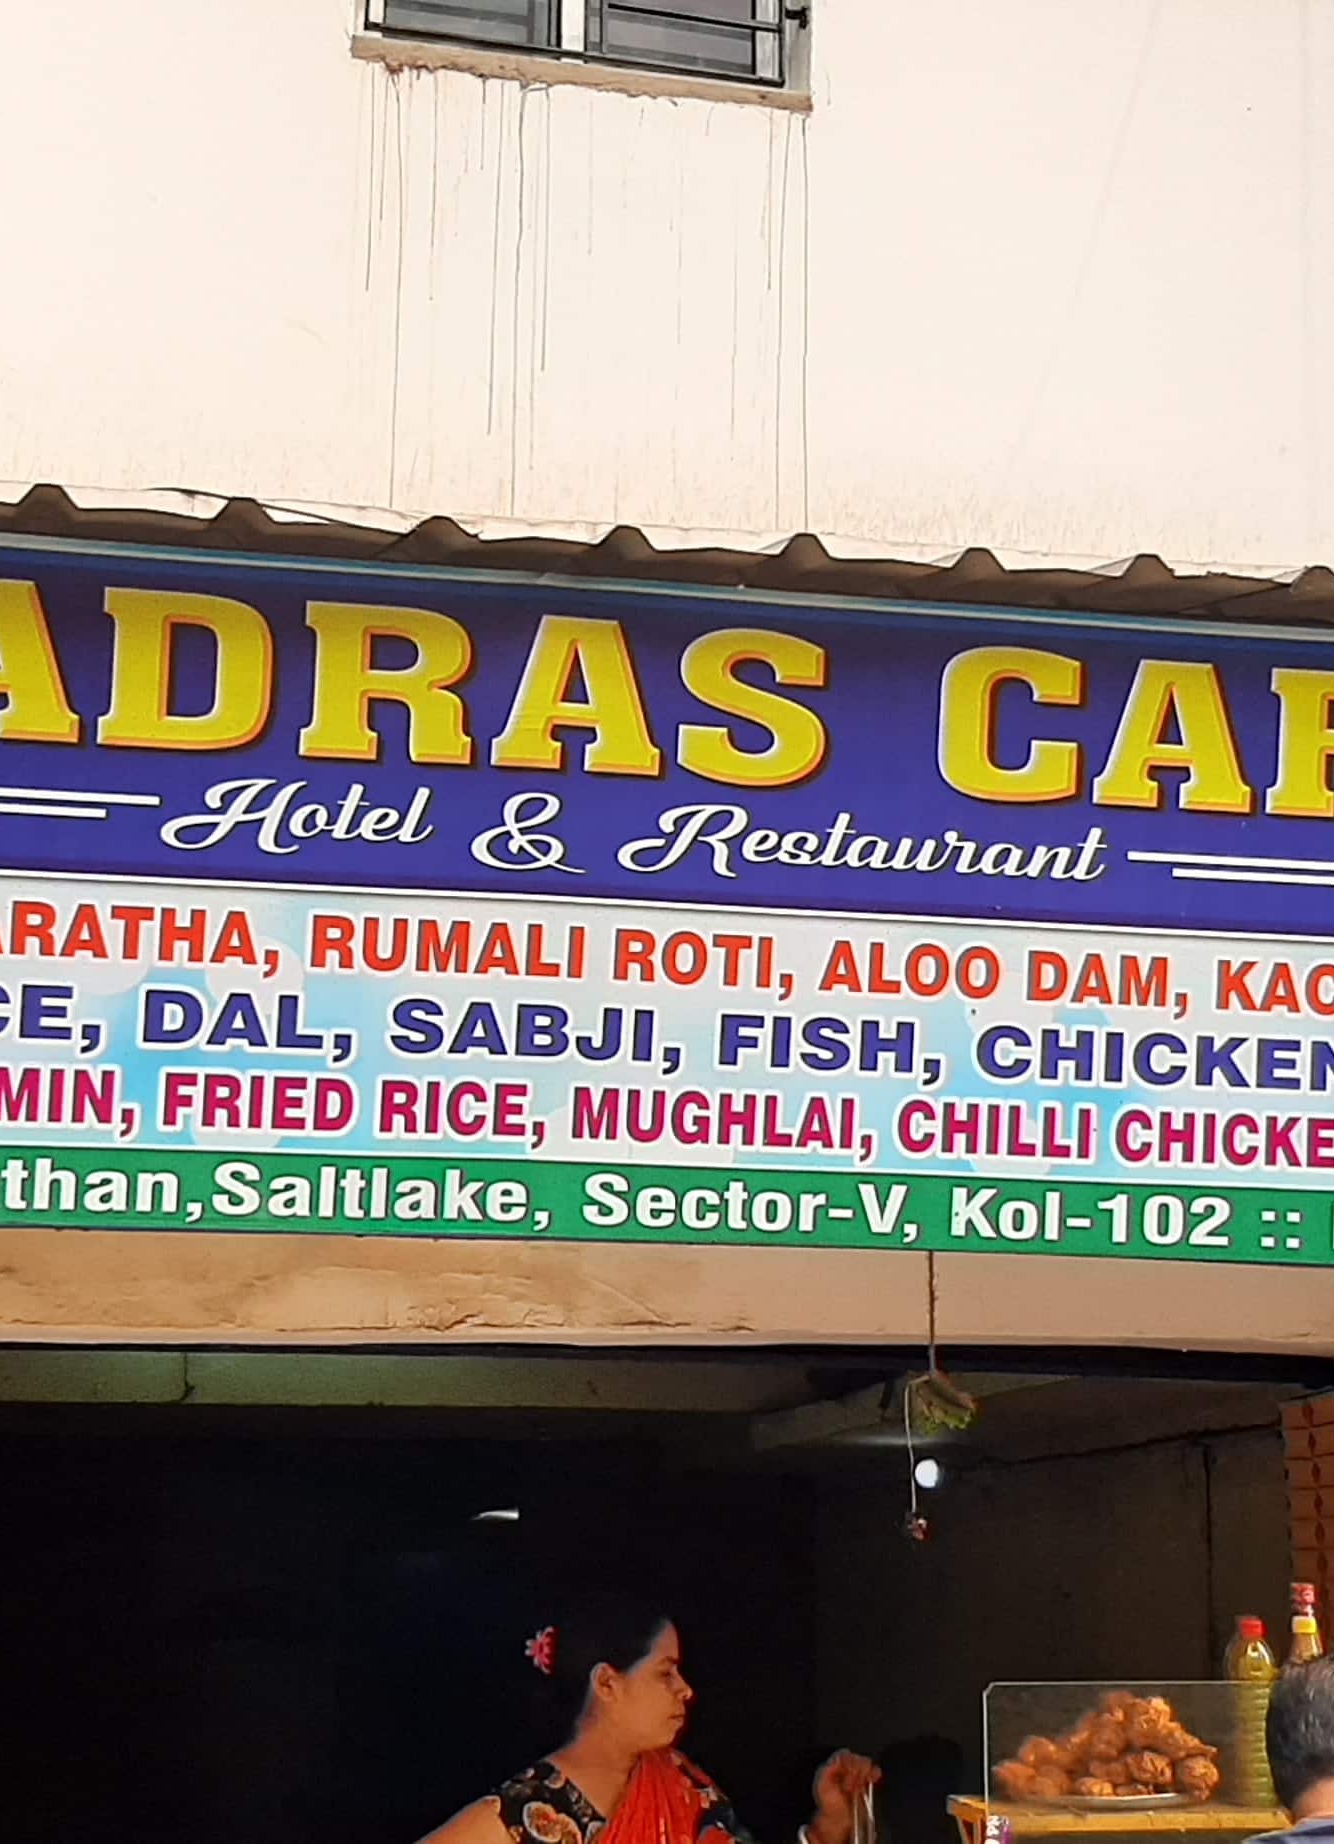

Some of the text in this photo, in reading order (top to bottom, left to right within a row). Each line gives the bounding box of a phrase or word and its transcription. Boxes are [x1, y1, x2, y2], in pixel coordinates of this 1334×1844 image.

[159, 778, 1107, 880] Hotel & Restaurant
[311, 915, 584, 979] RUMALI
[613, 928, 794, 1000] ROTI,
[819, 940, 1001, 999] ALOO
[1026, 950, 1189, 1019] DAM,
[143, 989, 353, 1062] DAL,
[390, 998, 681, 1073] SABJI,
[718, 1013, 942, 1084] FISH,
[161, 1071, 354, 1131] FRIED
[378, 1080, 546, 1149] RICE,
[570, 1088, 873, 1162] MUGHLAI,
[898, 1099, 1092, 1159] CHILLI
[583, 1173, 919, 1243] Sector-V,
[950, 1185, 1230, 1247] Kol-102
